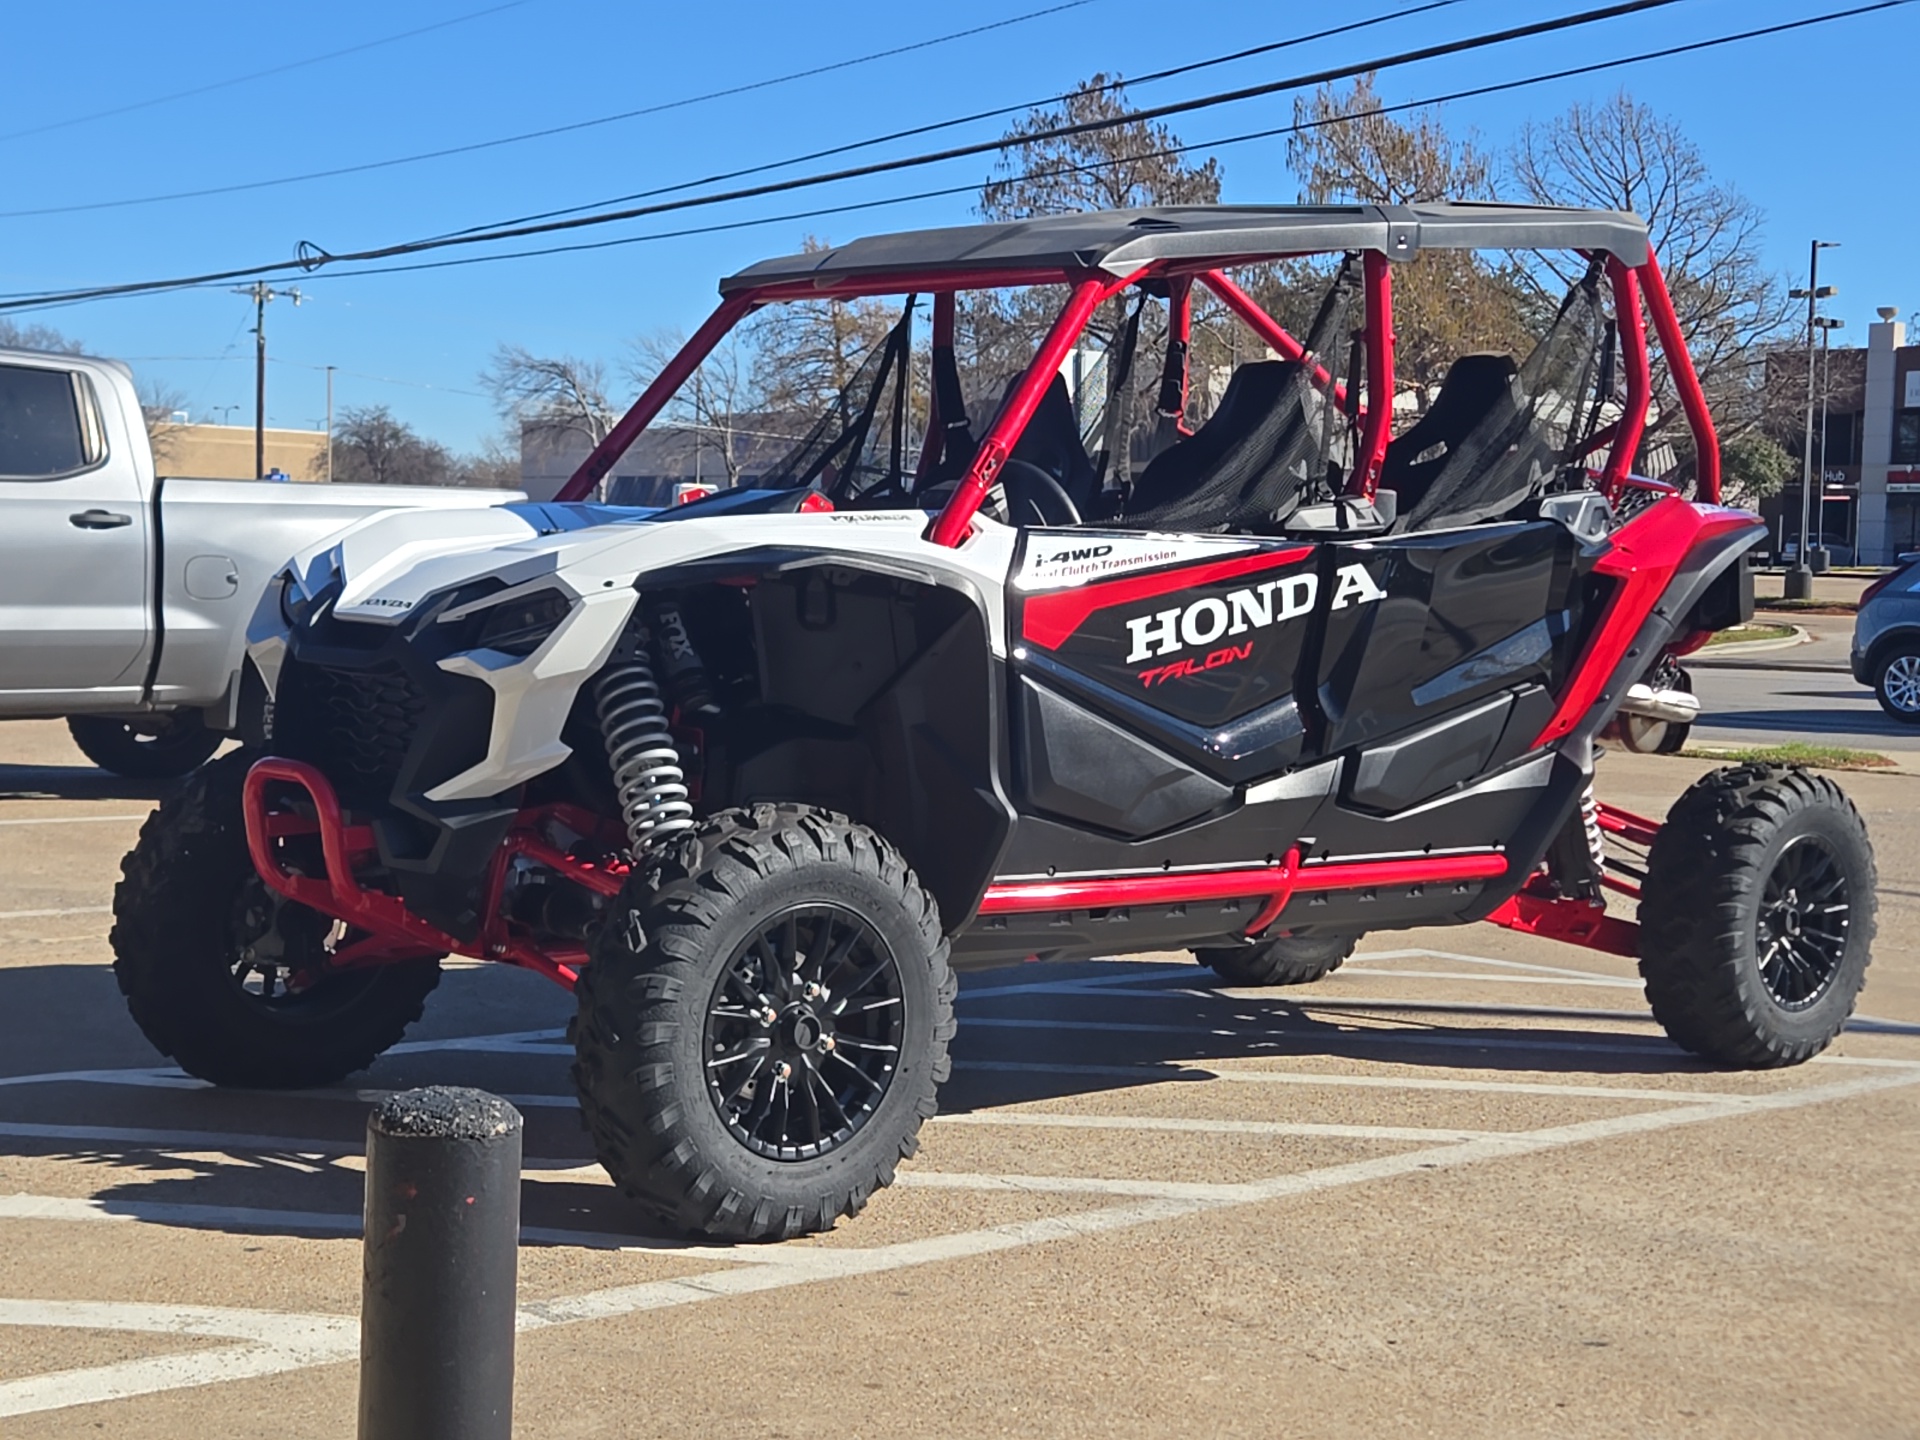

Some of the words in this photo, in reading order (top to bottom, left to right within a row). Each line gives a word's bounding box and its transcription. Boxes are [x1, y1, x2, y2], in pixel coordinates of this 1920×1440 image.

[1824, 469, 1846, 482] Hub
[1035, 545, 1113, 568] i-4WD
[1101, 551, 1177, 570] Transmission
[1126, 563, 1387, 664] HONDA
[659, 611, 695, 660] FOX
[1138, 641, 1253, 689] TALON
